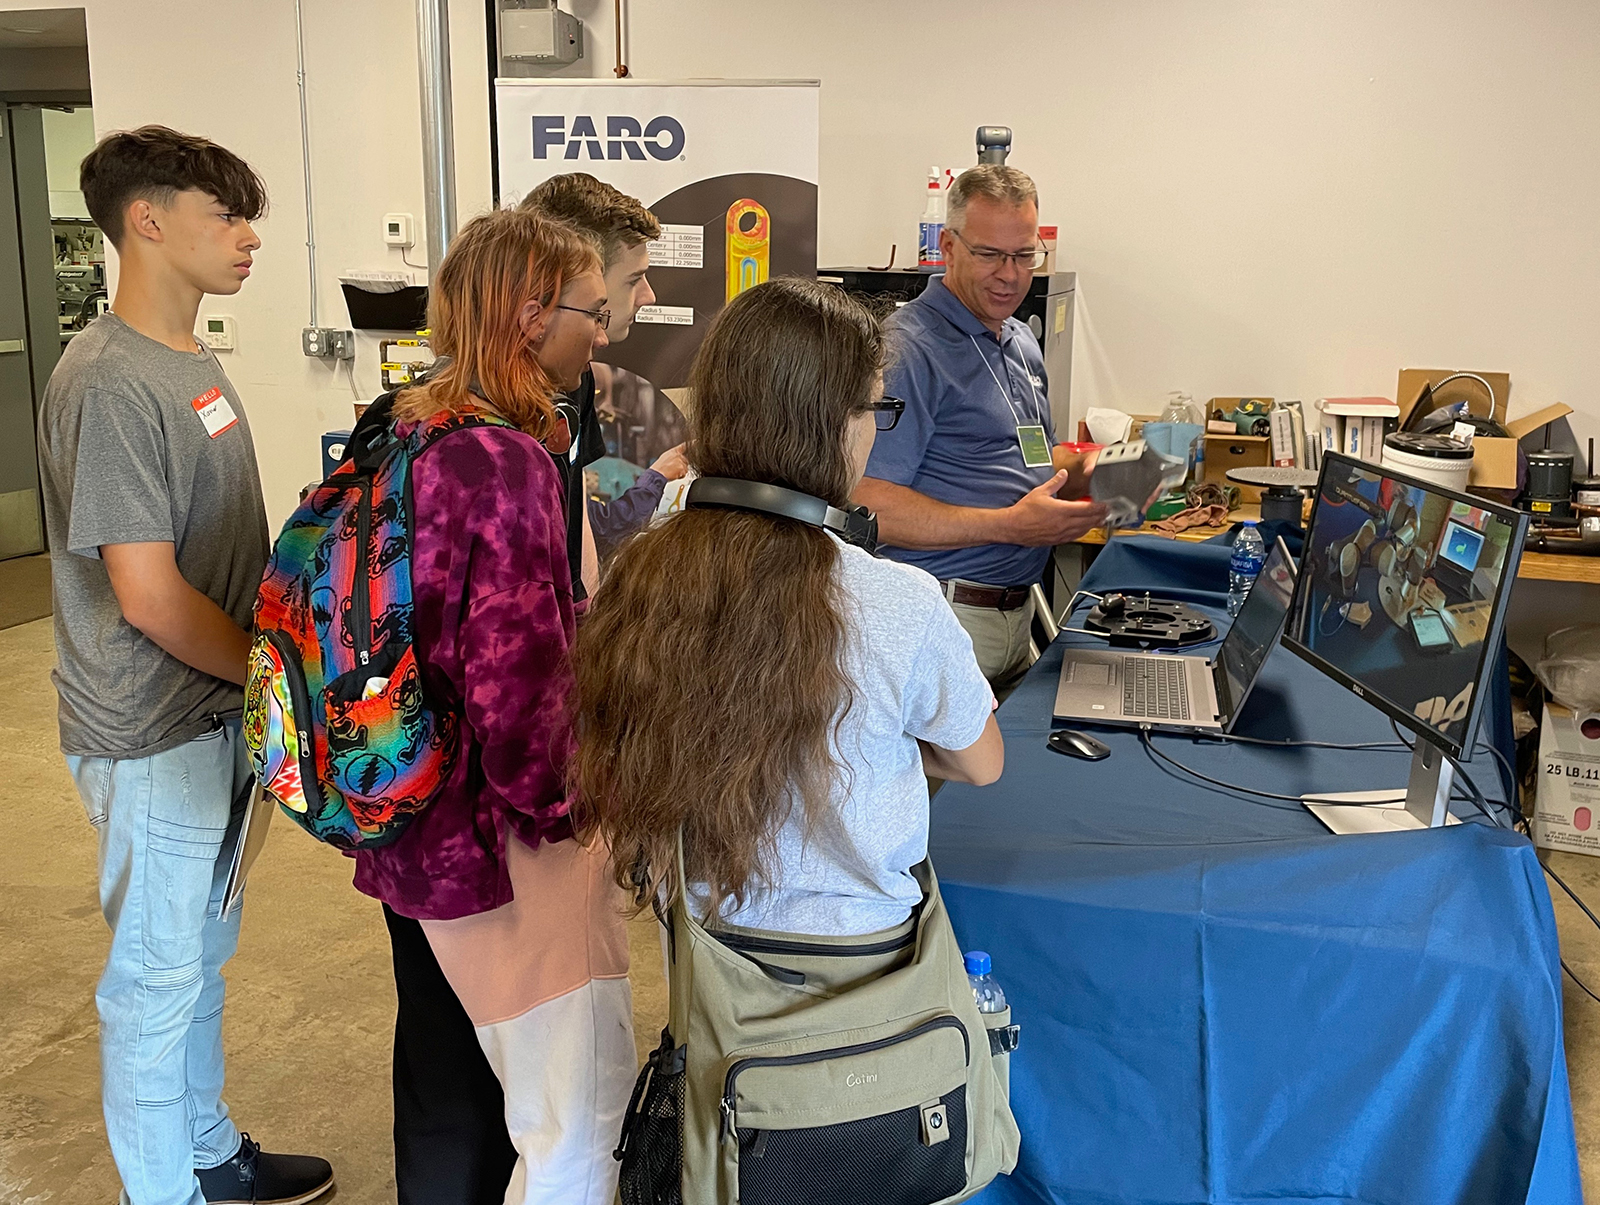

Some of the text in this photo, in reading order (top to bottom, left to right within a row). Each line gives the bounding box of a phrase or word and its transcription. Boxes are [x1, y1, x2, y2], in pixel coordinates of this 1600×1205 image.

[532, 115, 686, 161] FARO
[198, 389, 217, 404] HELLO
[1546, 763, 1562, 775] 25
